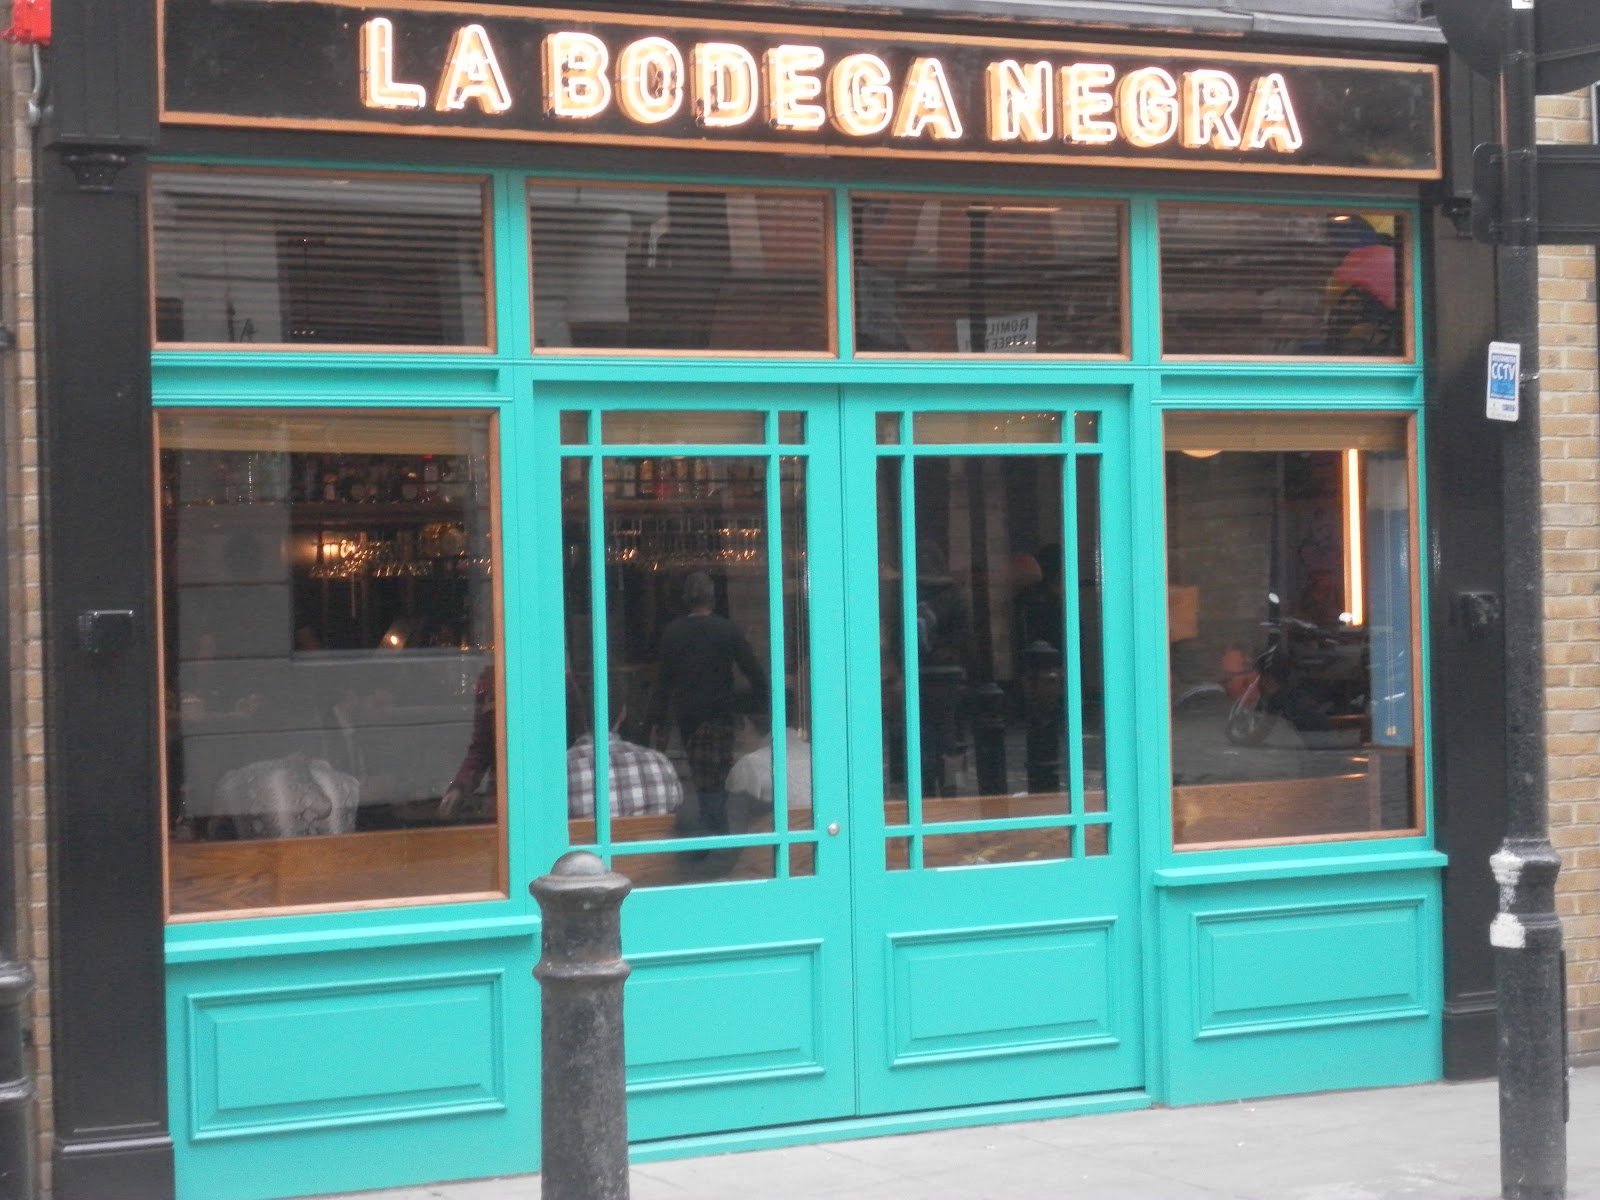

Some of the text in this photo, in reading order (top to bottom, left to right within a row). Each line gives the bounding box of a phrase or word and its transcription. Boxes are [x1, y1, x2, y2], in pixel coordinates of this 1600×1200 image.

[359, 17, 1303, 152] LA BODEGA NEGRA
[1491, 362, 1516, 381] CCTV
